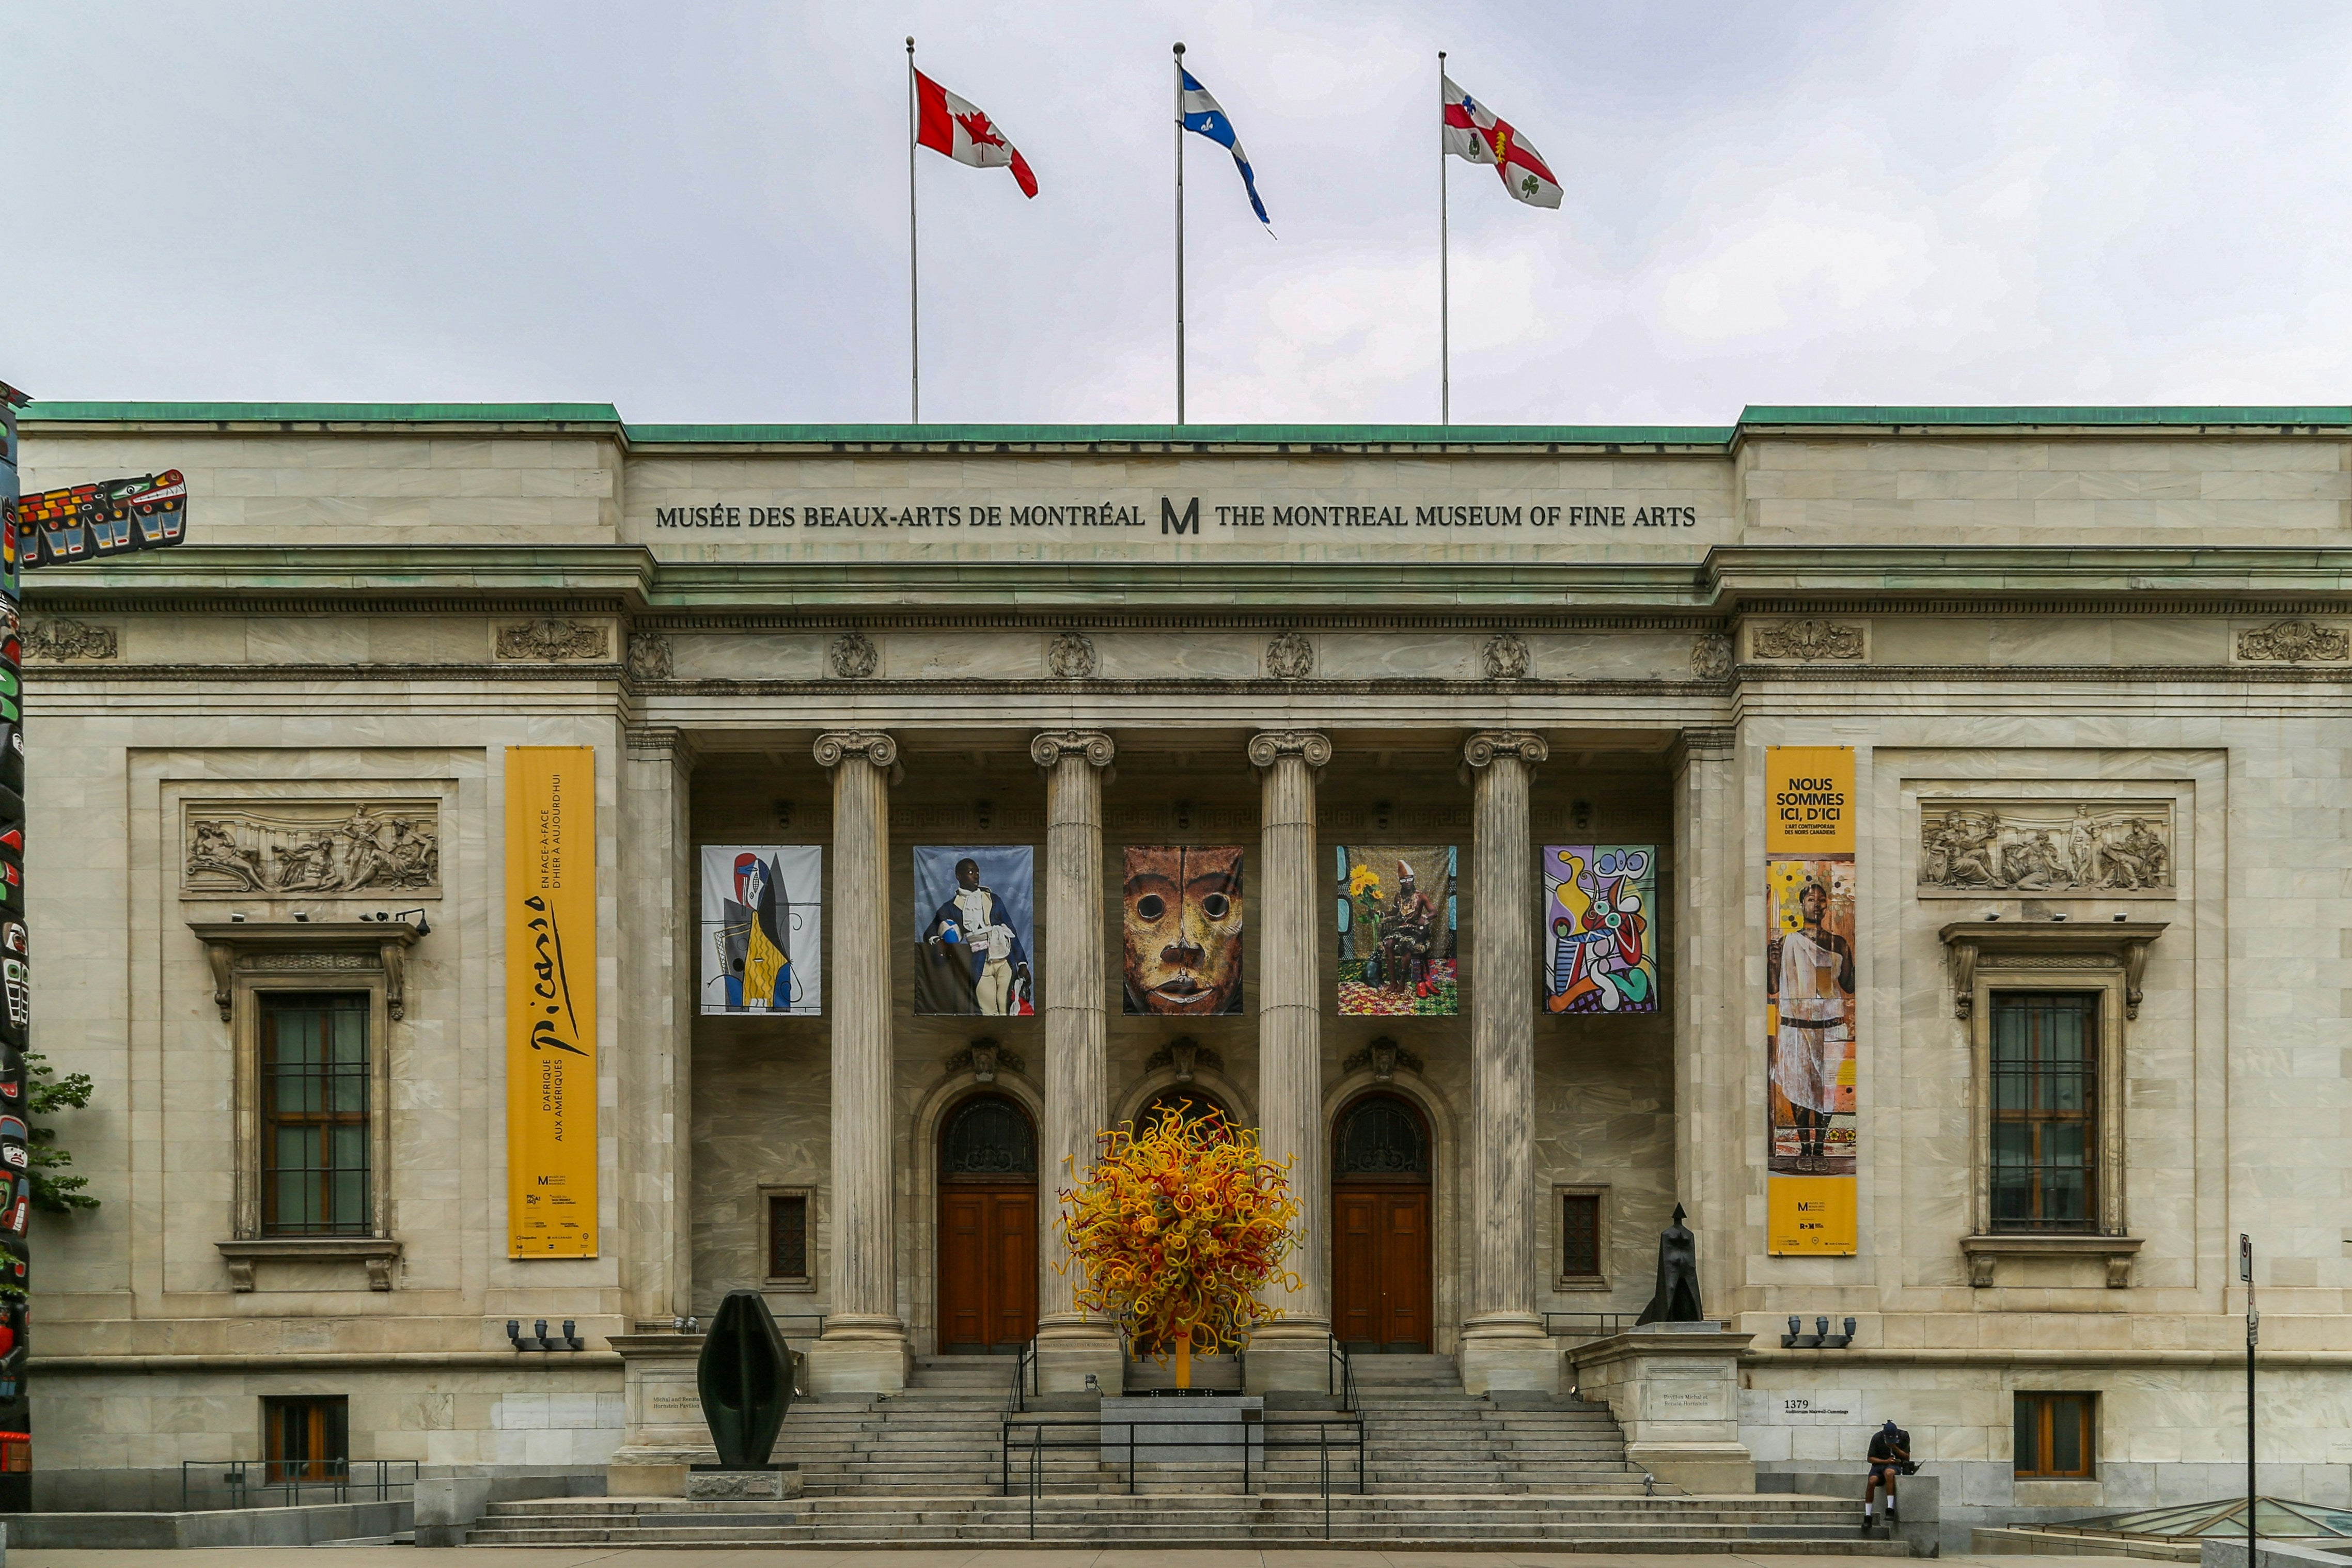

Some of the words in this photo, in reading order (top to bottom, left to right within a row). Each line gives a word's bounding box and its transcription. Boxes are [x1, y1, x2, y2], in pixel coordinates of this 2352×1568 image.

[655, 502, 741, 528] MUSÉE
[748, 506, 795, 527] DES
[803, 506, 962, 527] BEAUX-ARTS
[969, 506, 1002, 527] DE
[1010, 501, 1146, 527] MONTRÉAL
[1161, 498, 1199, 535] M
[1215, 506, 1265, 527] THE
[1273, 506, 1408, 527] MONTREAL
[1415, 506, 1523, 526] MUSEUM
[1530, 506, 1561, 527] OF
[1569, 506, 1626, 527] FINE
[1632, 507, 1696, 527] ARTS
[1789, 778, 1832, 791] NOUS
[552, 774, 561, 844] AUJOURD'HUI
[1776, 793, 1844, 806] SOMMES
[1780, 807, 1802, 822] ICI,
[1807, 808, 1840, 821] D'ICI
[540, 809, 549, 873] FACE-À-FACE
[541, 876, 549, 888] EN
[553, 857, 561, 888] D'HIER
[542, 1059, 552, 1111] D'AFRIQUE
[553, 1059, 563, 1118] AMÉRIQUES
[555, 1120, 563, 1142] AUX
[1784, 1400, 1809, 1409] 1379
